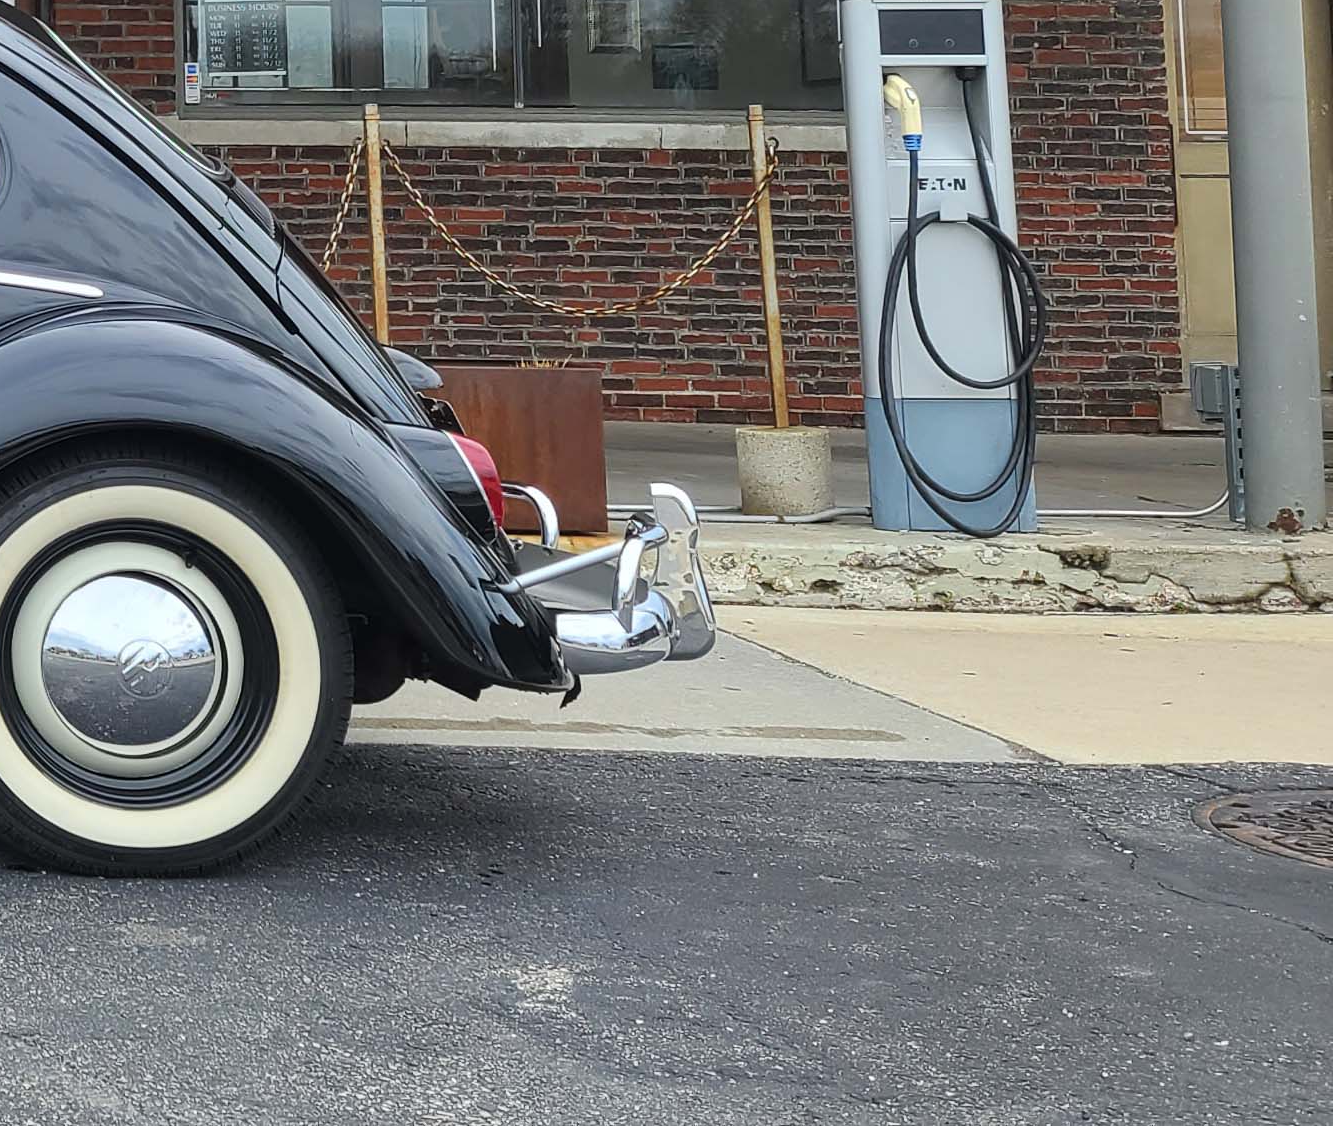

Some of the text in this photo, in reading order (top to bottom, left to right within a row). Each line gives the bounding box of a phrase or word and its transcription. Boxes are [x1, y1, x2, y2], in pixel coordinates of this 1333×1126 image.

[208, 3, 279, 12] BUSINESS HOURS
[918, 178, 967, 191] EATON
